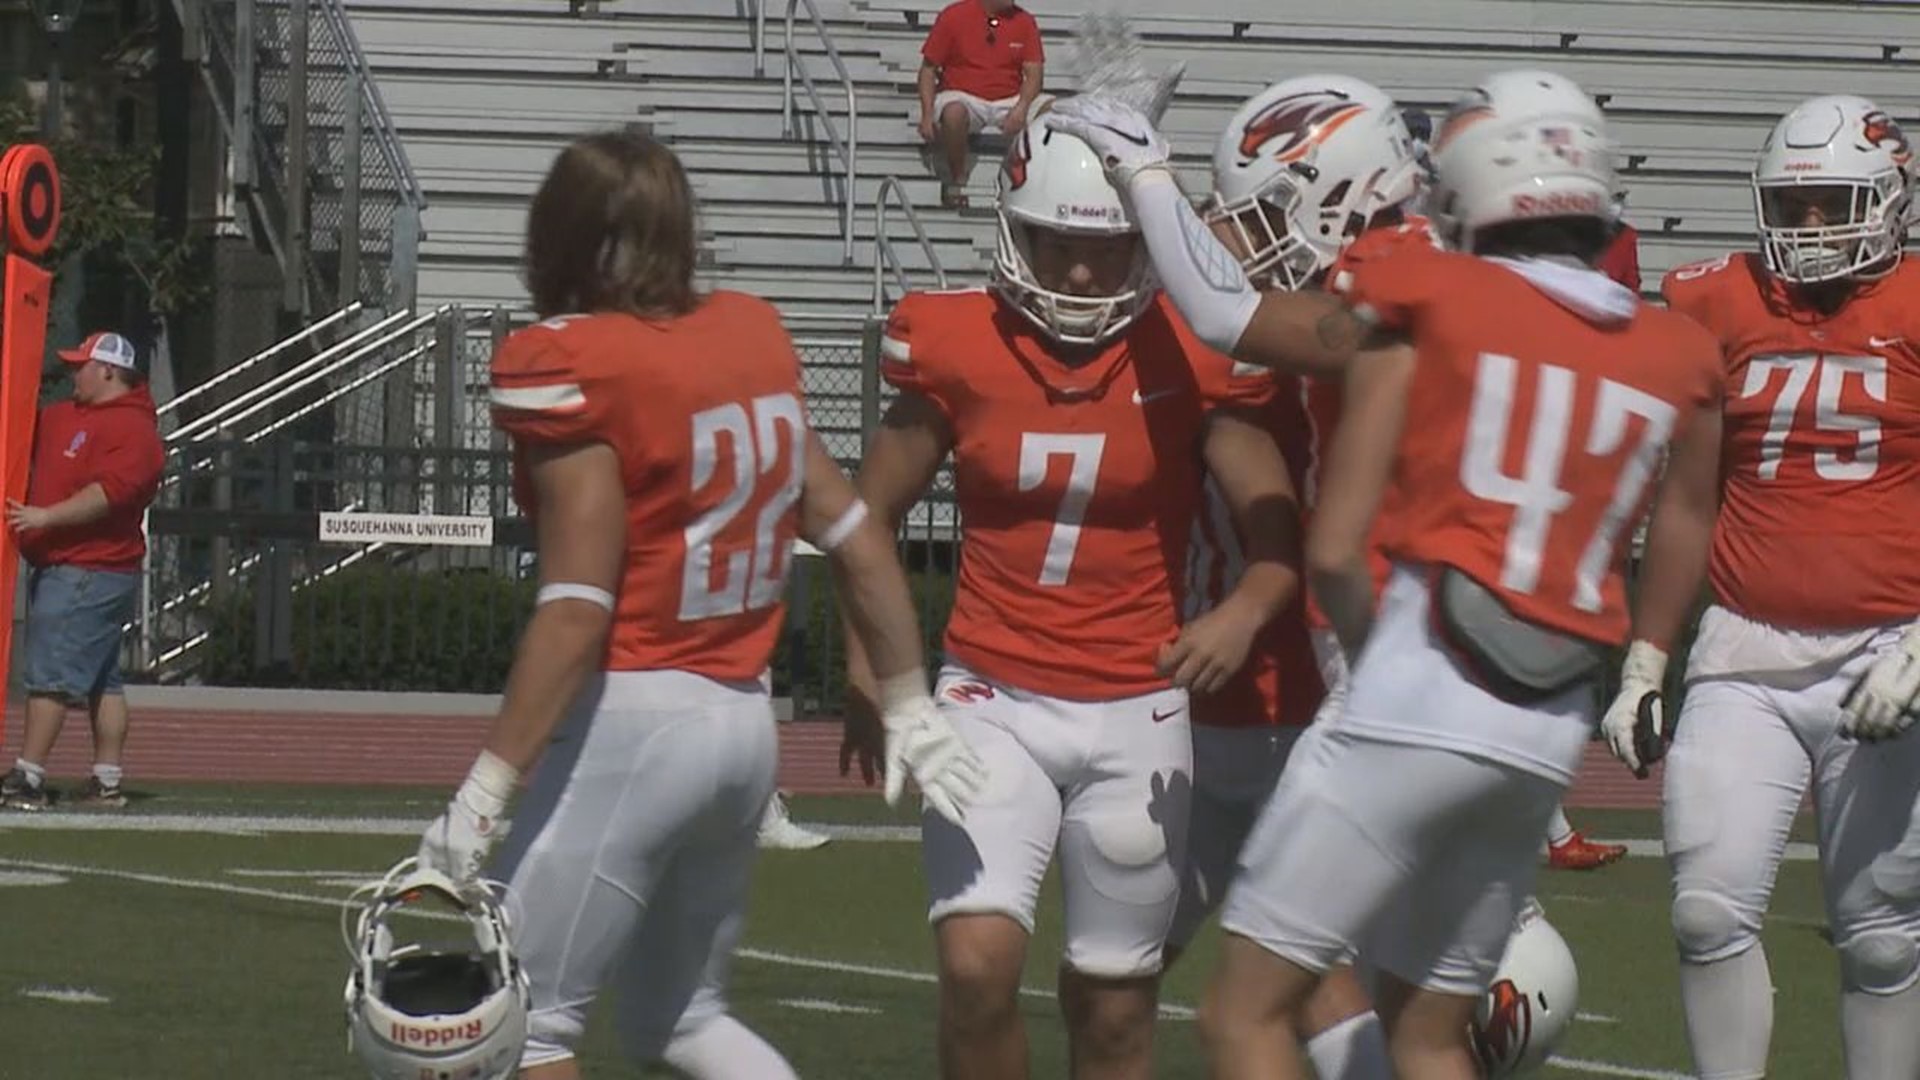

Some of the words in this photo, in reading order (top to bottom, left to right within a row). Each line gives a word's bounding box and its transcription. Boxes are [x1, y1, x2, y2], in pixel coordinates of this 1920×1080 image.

[1458, 351, 1678, 614] 47
[1740, 354, 1888, 481] 75
[325, 519, 413, 536] SUSQUEHANNA
[416, 523, 487, 538] UNIVERSITY
[677, 392, 806, 621] 22
[1018, 431, 1107, 586] 7
[391, 1019, 483, 1046] Riddell
